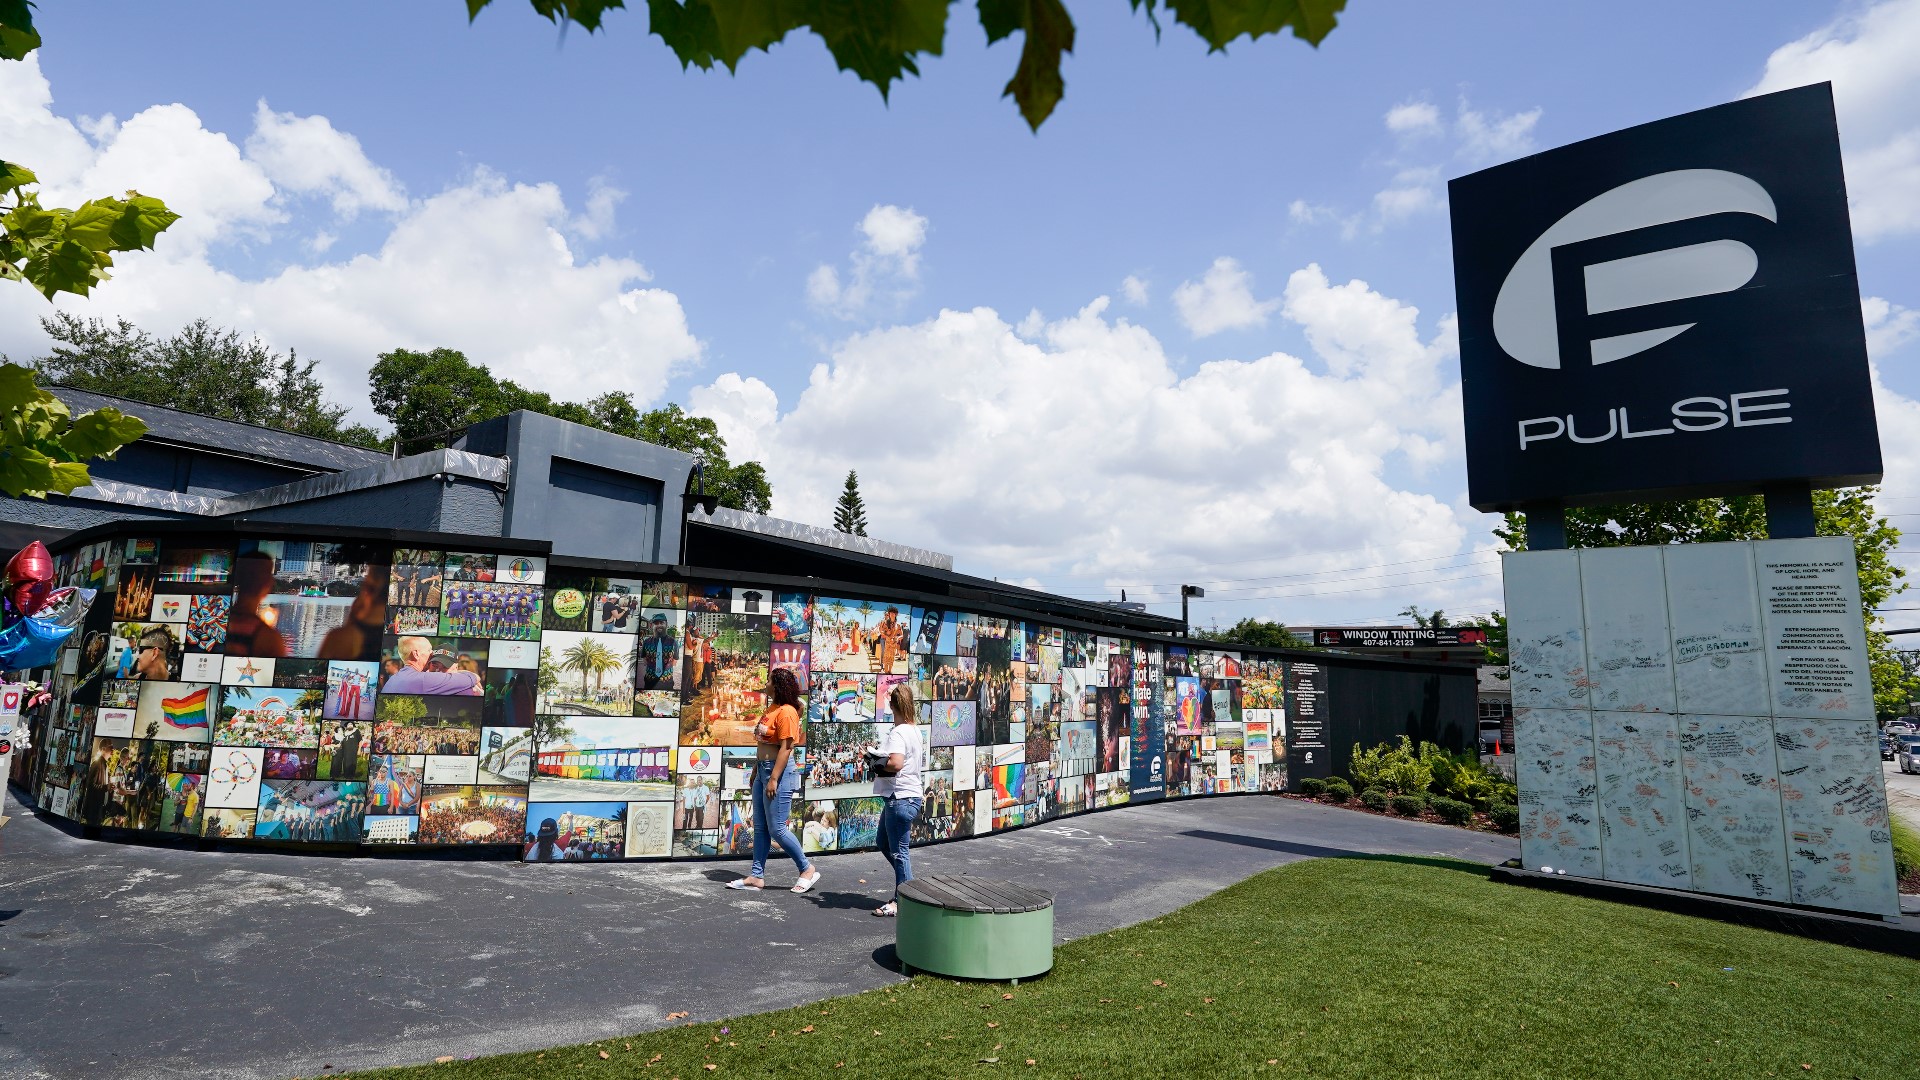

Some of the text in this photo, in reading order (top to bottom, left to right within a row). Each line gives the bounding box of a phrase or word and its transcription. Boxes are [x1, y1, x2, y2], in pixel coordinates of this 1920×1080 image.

[1517, 388, 1793, 451] PULSE
[1343, 630, 1388, 639] WINDOW
[1391, 630, 1435, 639] TINTING
[1458, 630, 1486, 644] 3M
[1134, 647, 1161, 665] We will
[1134, 666, 1159, 682] not let
[1134, 684, 1151, 700] hate
[1133, 701, 1150, 718] win.
